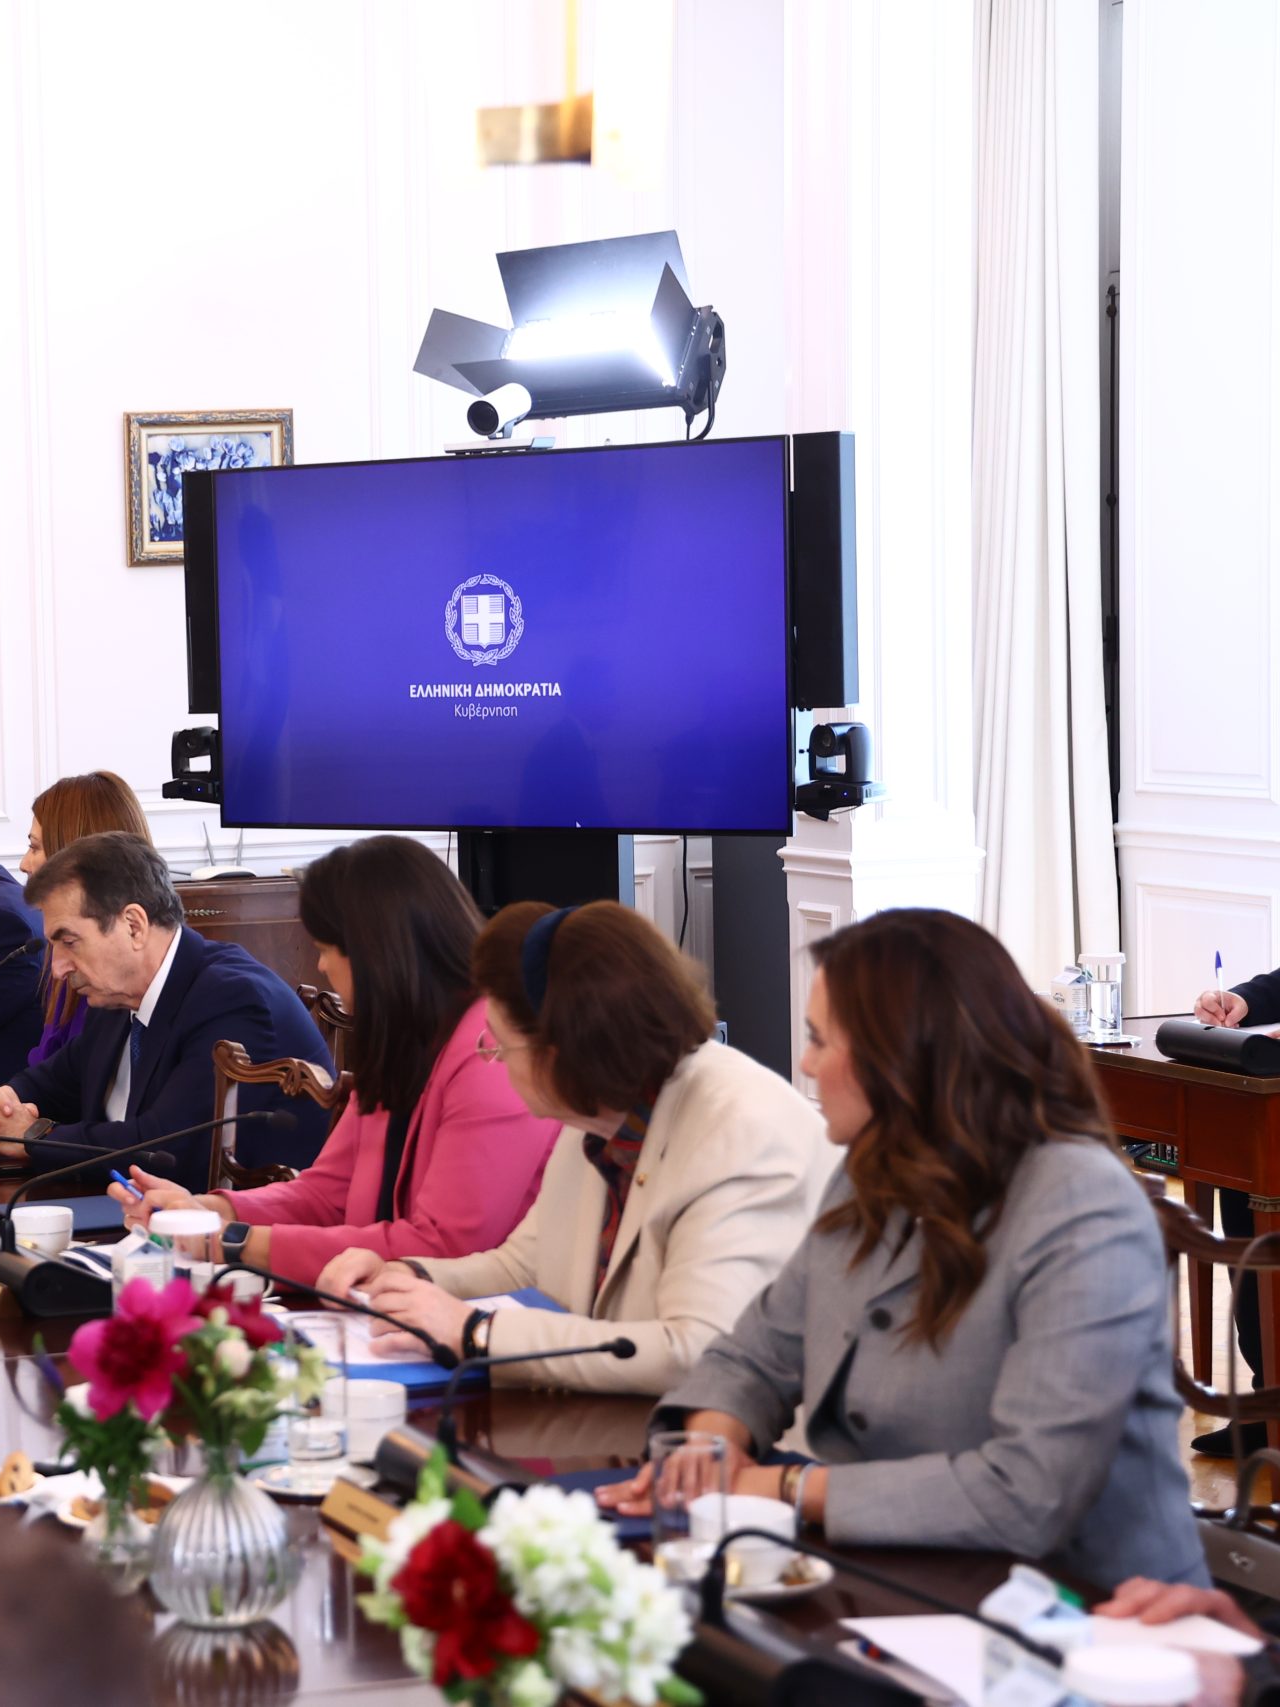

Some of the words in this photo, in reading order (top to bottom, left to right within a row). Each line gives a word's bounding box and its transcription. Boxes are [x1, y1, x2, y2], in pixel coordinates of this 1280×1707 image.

[409, 684, 472, 698] ΕΛΛΗΝΙΚΗ
[475, 682, 562, 697] ΔΗΜΟΚΡΑΤΙΑ
[454, 703, 518, 720] Κυβέρνηση
